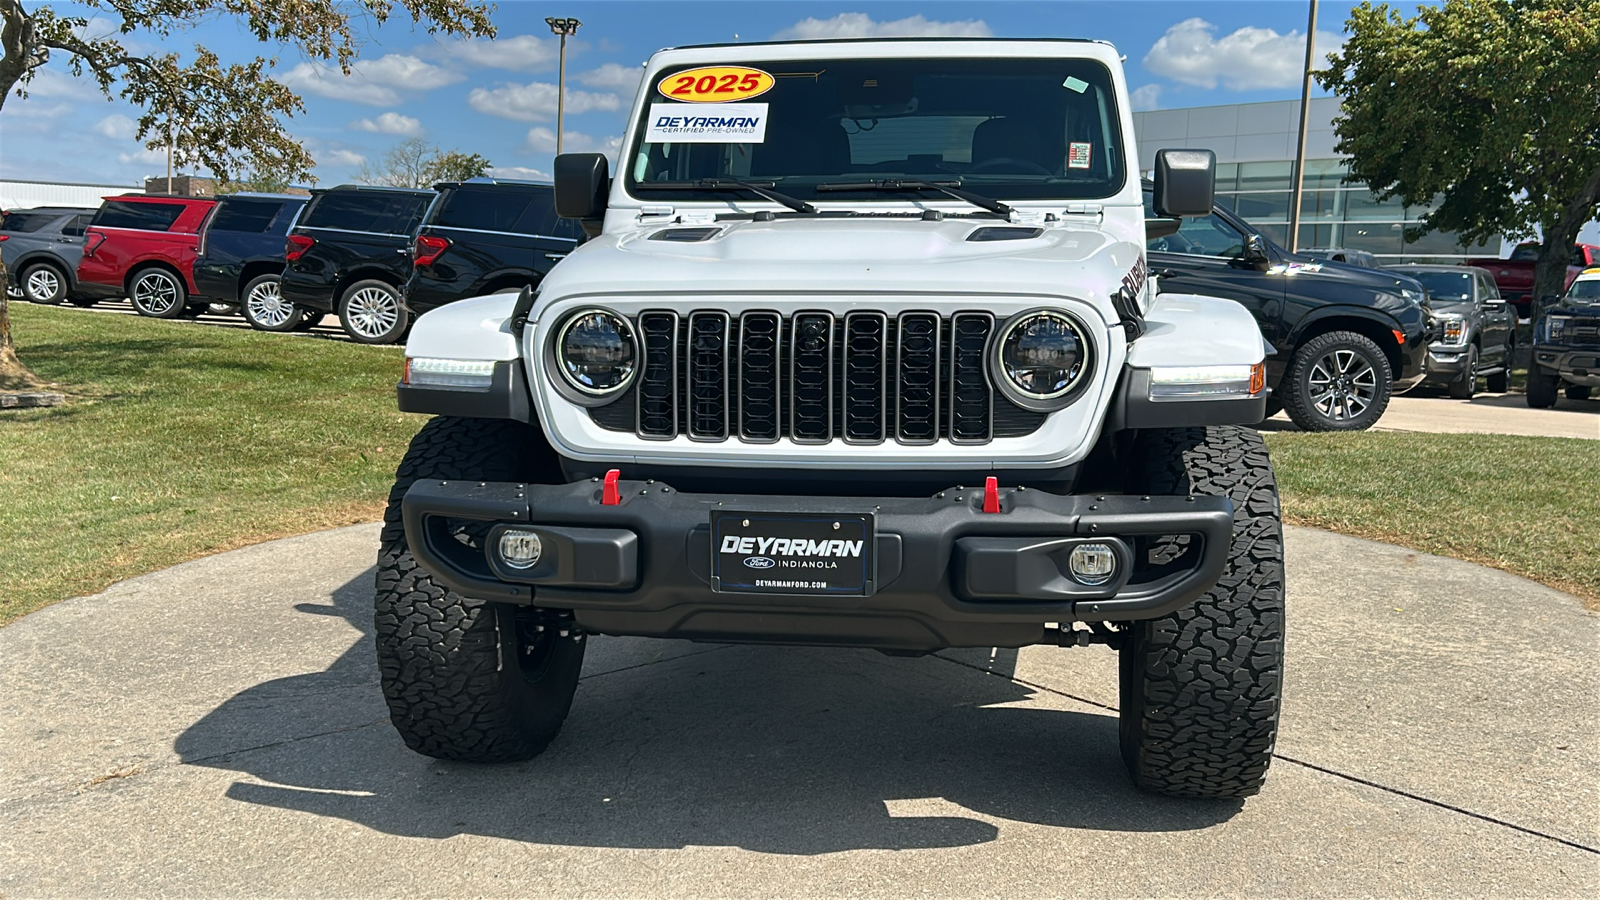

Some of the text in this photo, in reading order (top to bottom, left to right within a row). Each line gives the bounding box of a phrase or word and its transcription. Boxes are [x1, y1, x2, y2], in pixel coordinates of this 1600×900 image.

[671, 73, 762, 95] 2025
[655, 116, 760, 128] DEYARMAN
[720, 535, 864, 558] DEYARMAN
[747, 557, 838, 569] Ford INDIANOLA
[755, 579, 827, 589] DEYARMANFORD.COM
